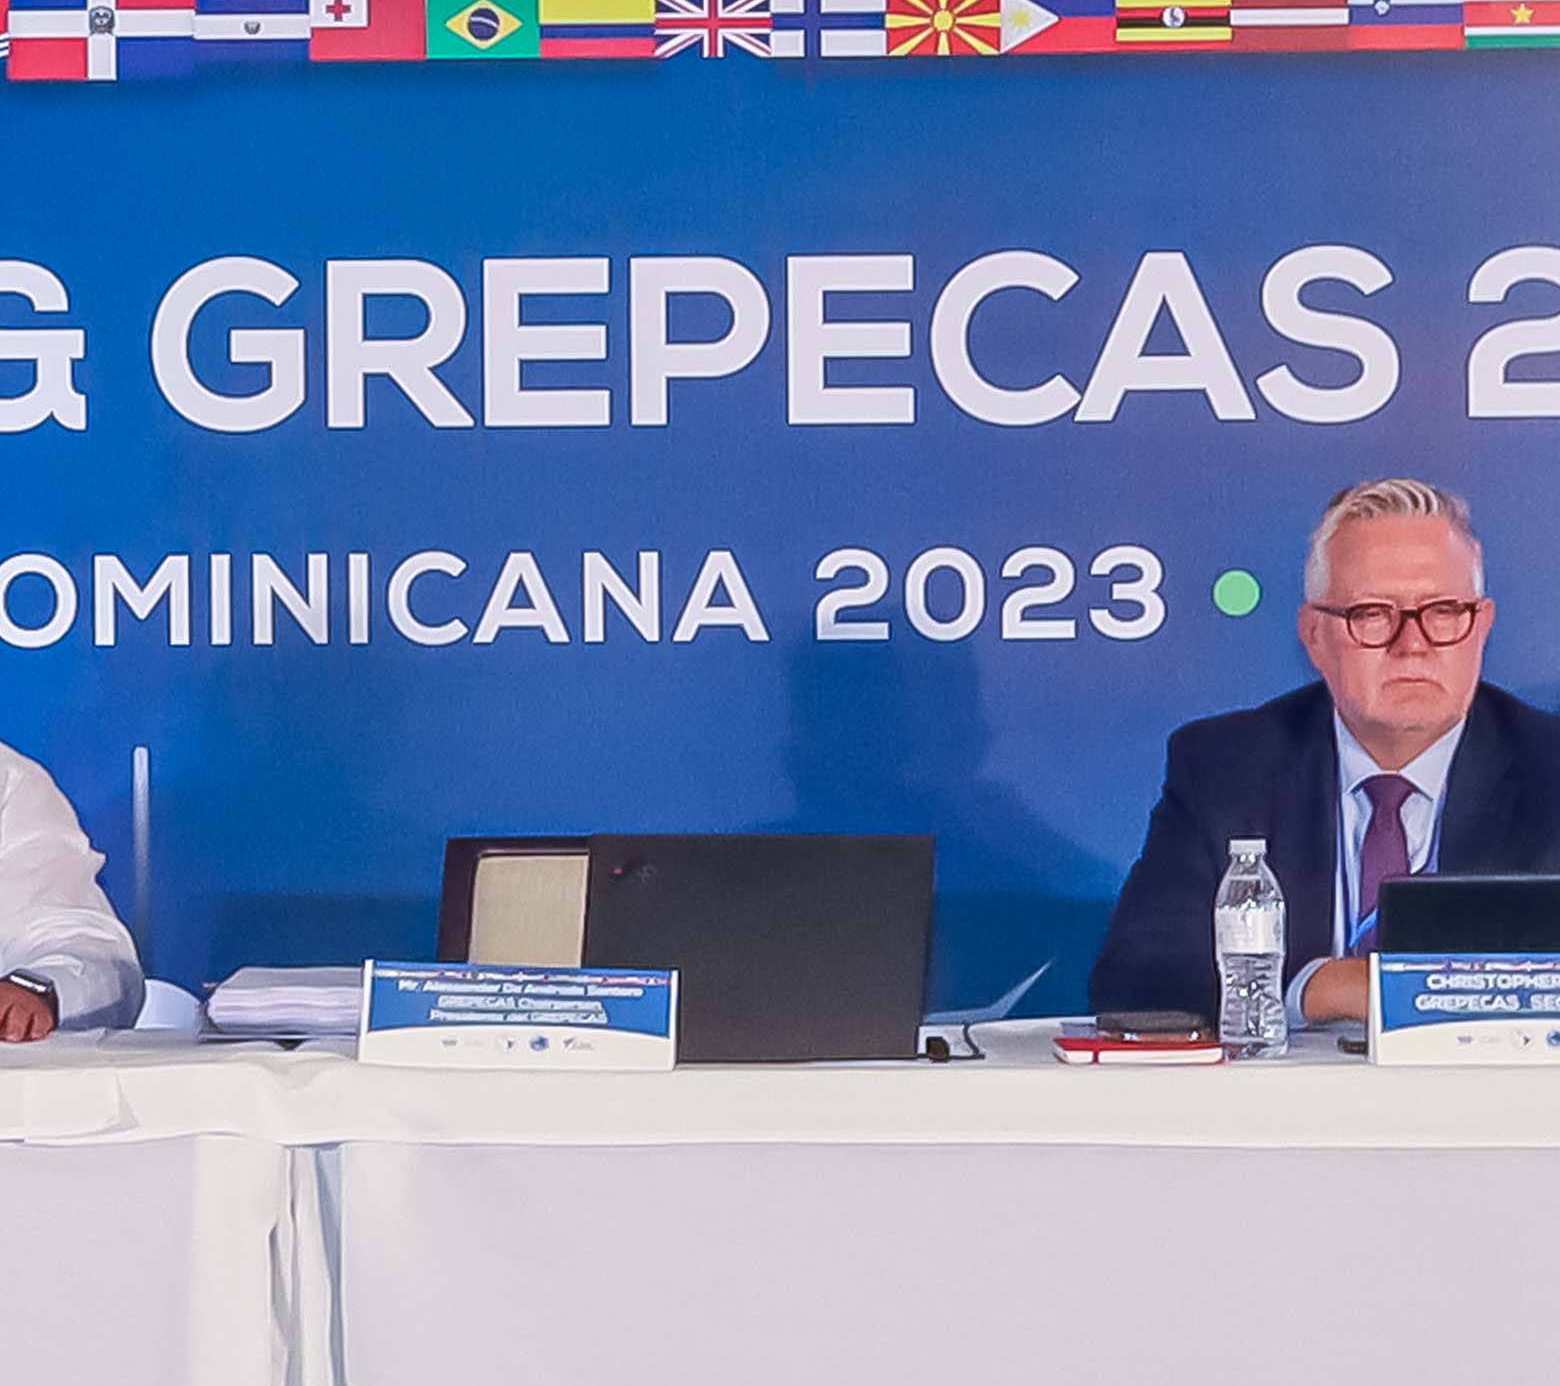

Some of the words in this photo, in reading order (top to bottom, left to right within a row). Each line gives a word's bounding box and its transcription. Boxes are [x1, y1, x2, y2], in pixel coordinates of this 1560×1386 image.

[150, 246, 1402, 431] GREPECAS
[815, 544, 1166, 641] 2023
[1415, 994, 1520, 1011] GREPECAS
